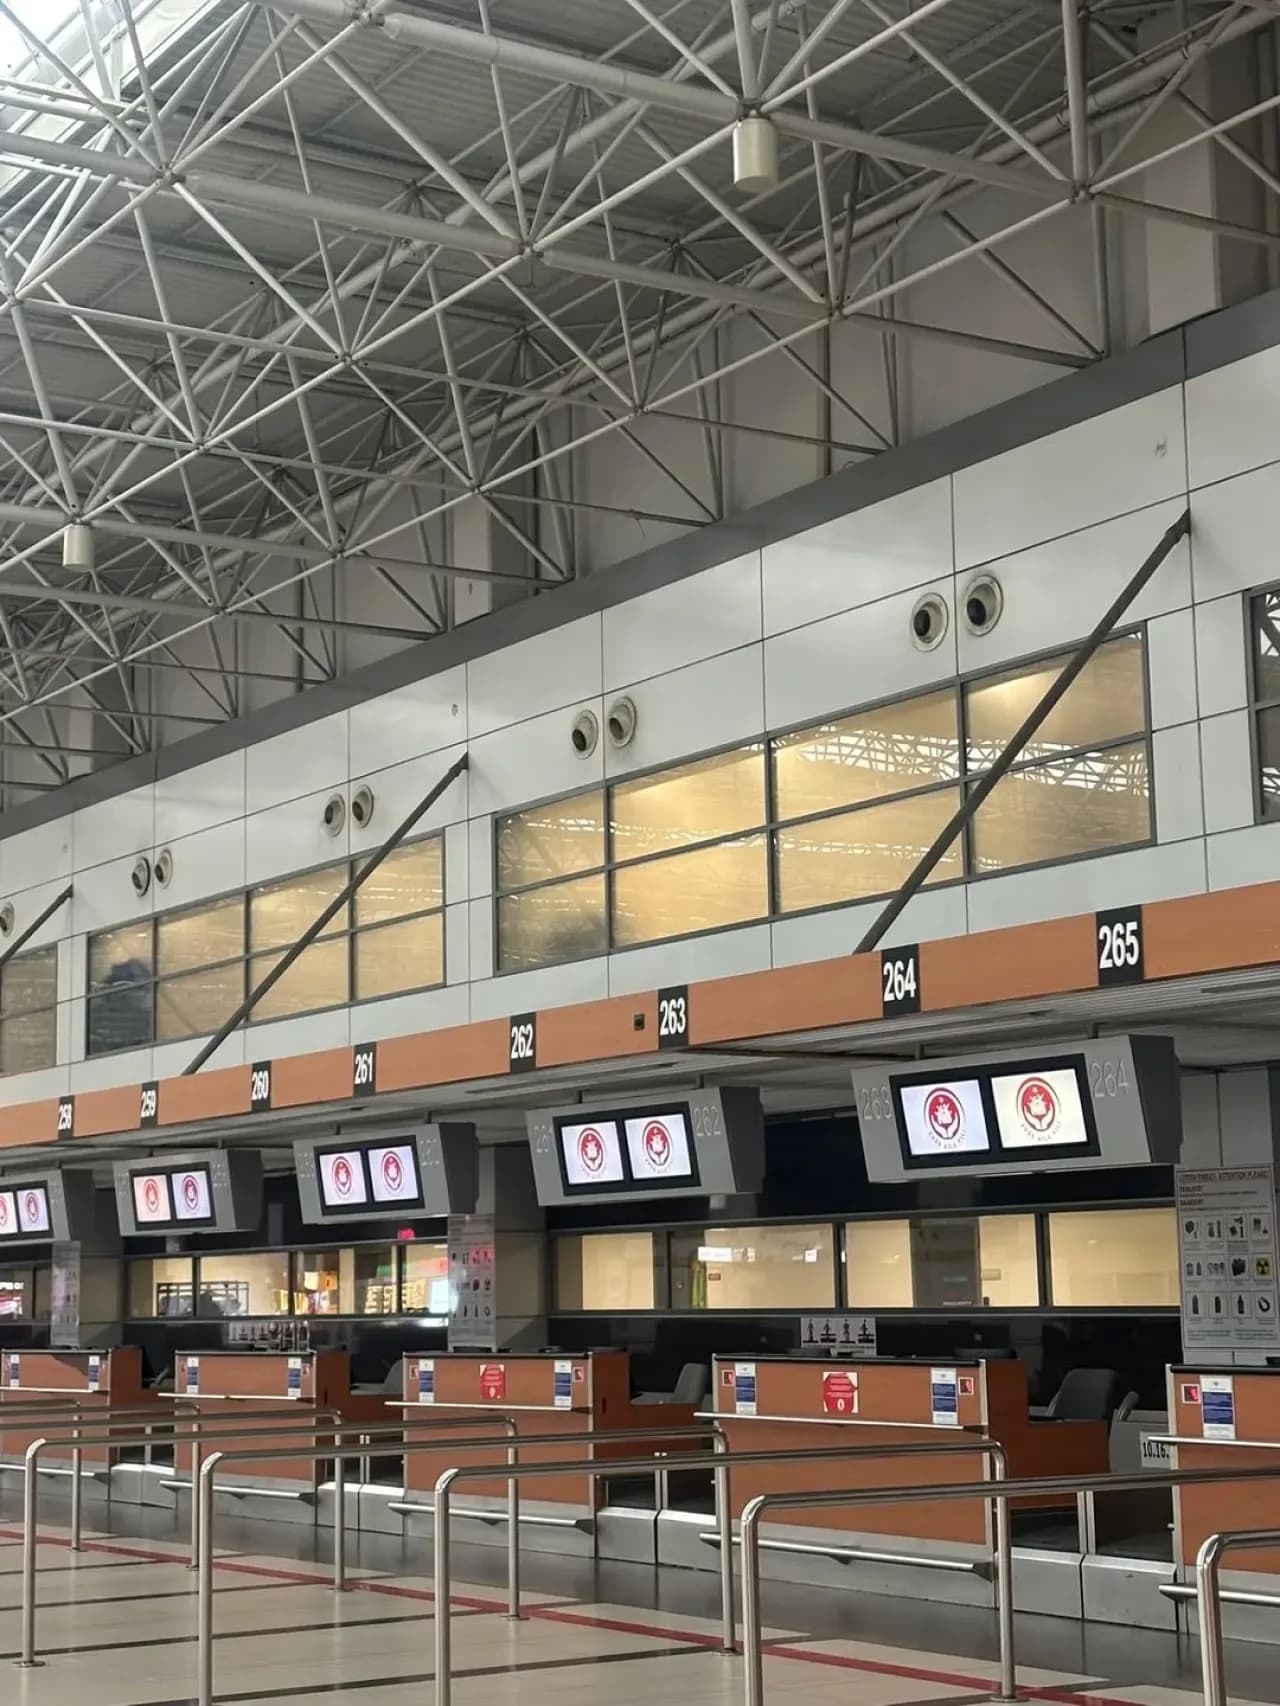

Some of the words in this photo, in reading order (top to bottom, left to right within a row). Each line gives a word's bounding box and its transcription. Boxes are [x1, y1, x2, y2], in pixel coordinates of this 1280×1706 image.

[1099, 921, 1139, 968] 265
[883, 958, 917, 1002] 264
[659, 998, 686, 1035] 263
[511, 1024, 533, 1059] 262
[251, 1070, 269, 1100] 260
[354, 1052, 373, 1084] 261
[1092, 1059, 1129, 1098] 264
[140, 1090, 156, 1118] 259
[693, 1104, 722, 1136] 262
[861, 1086, 891, 1120] 263
